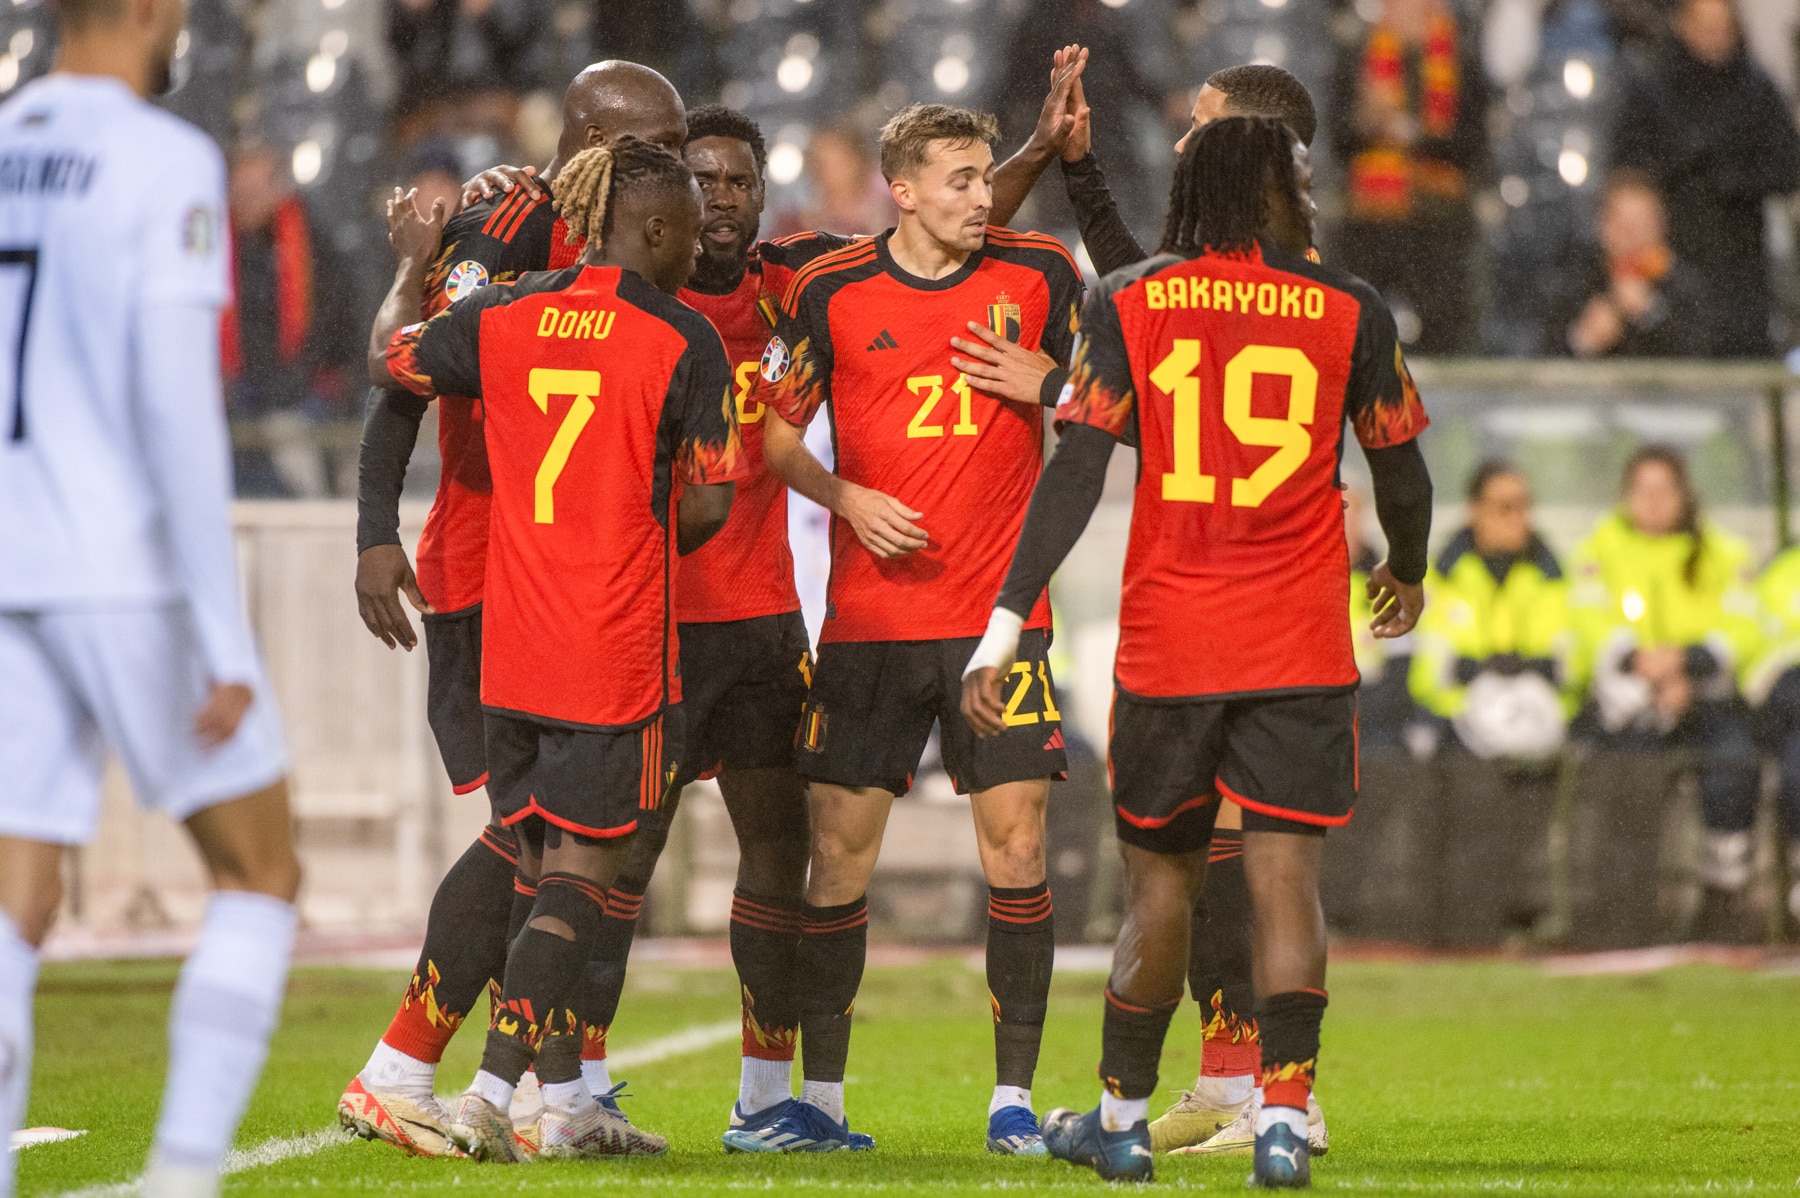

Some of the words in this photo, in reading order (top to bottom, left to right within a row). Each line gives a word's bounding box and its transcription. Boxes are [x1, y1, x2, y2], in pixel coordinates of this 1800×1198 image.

[537, 306, 616, 339] DOKU
[1144, 276, 1324, 319] BAKAYOKO
[906, 372, 978, 438] 21
[1149, 338, 1318, 508] 19
[528, 367, 601, 524] 7
[1001, 660, 1061, 727] 21
